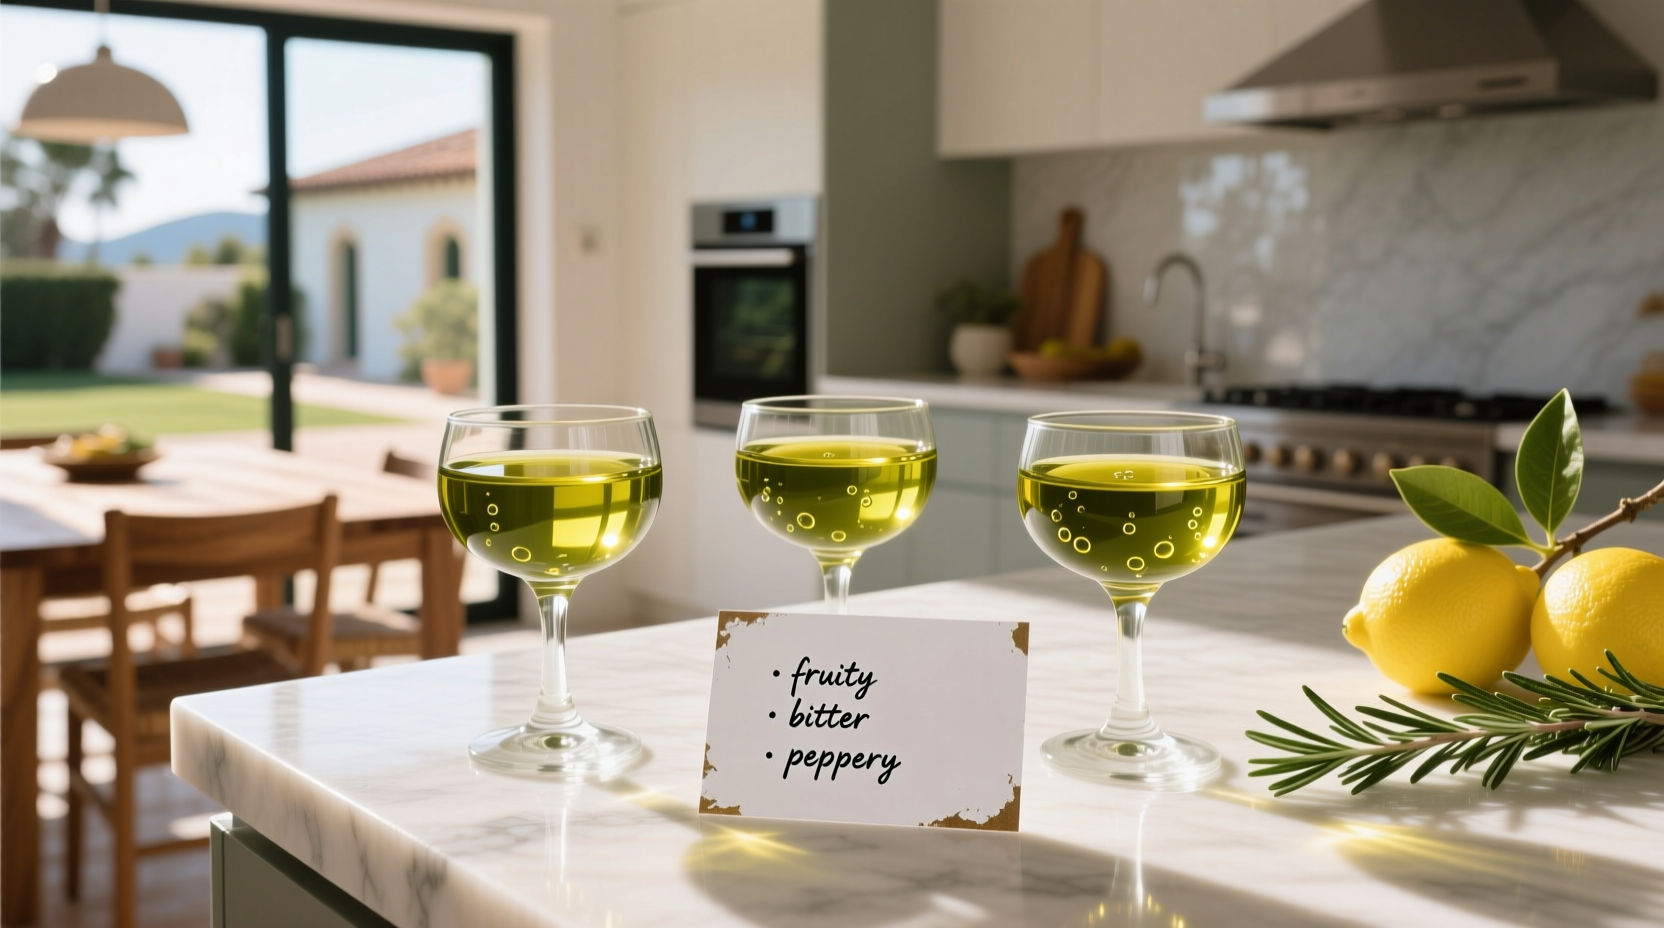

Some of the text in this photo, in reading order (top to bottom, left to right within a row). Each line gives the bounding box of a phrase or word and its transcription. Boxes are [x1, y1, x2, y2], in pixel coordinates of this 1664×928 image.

[790, 656, 878, 700] fruity
[788, 697, 869, 729] bitter
[782, 748, 902, 785] peppery
